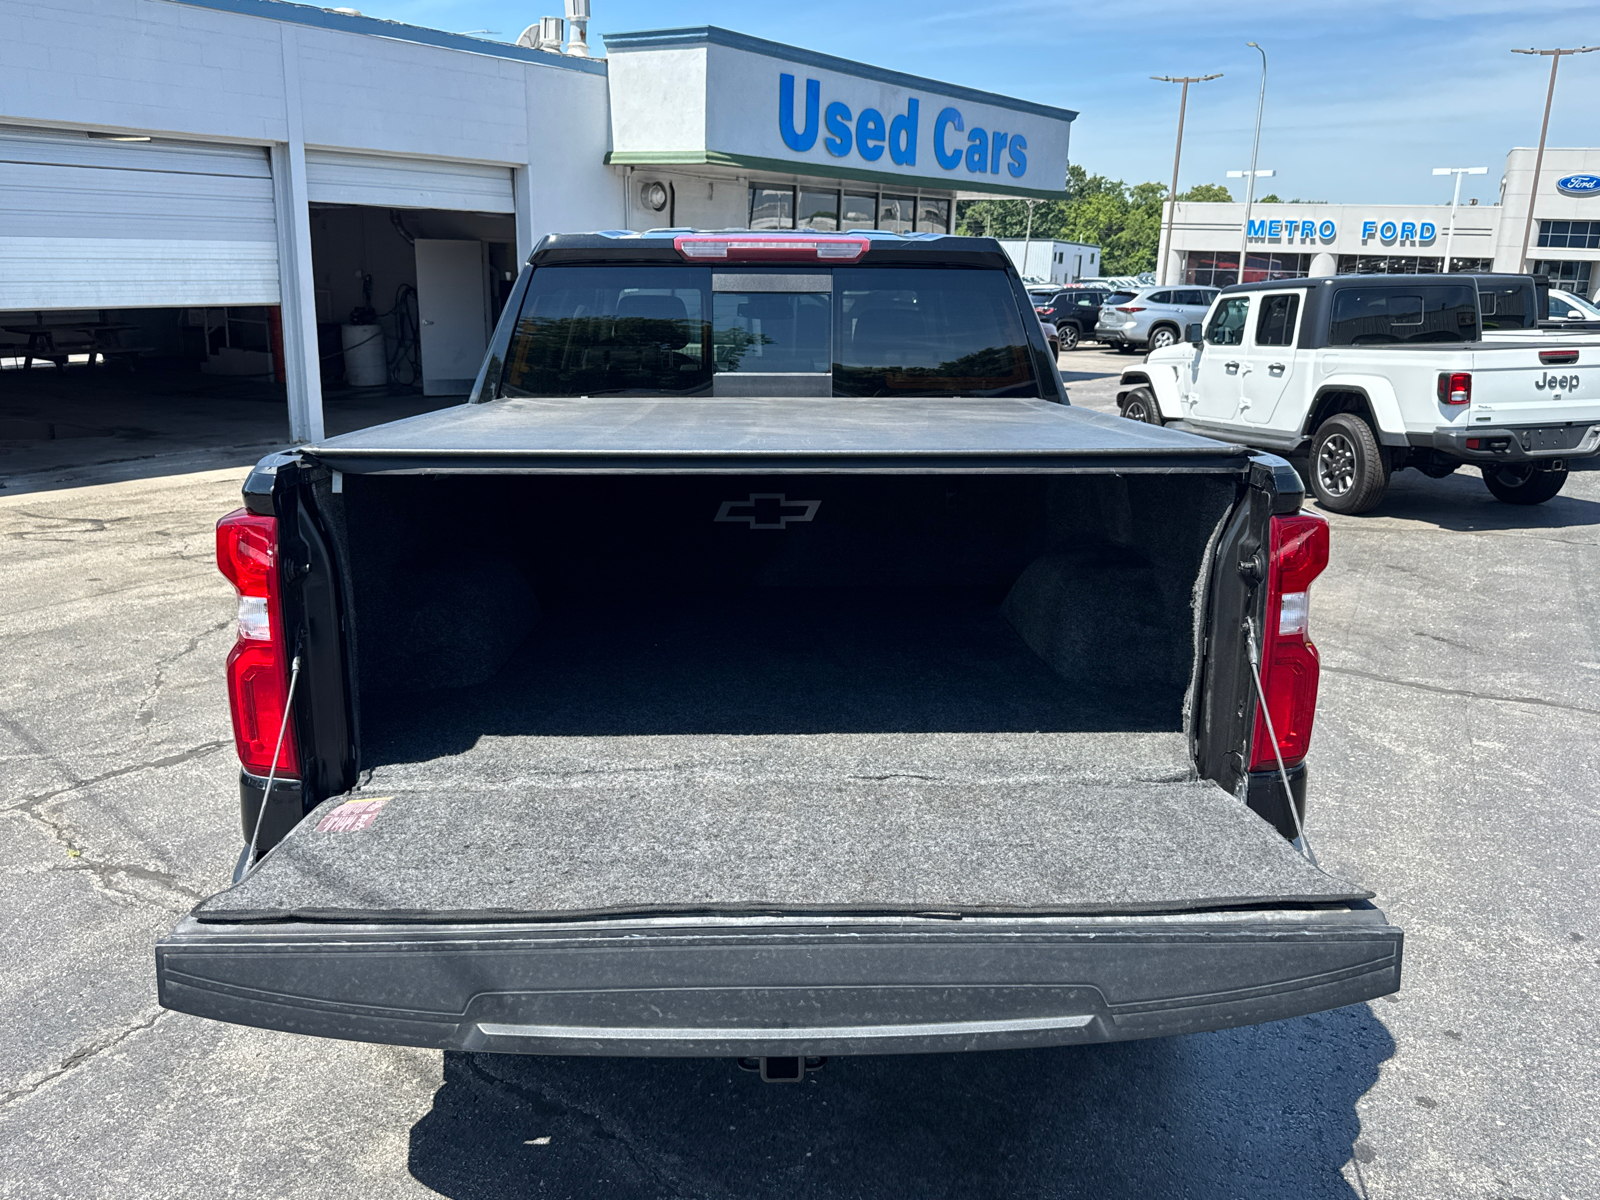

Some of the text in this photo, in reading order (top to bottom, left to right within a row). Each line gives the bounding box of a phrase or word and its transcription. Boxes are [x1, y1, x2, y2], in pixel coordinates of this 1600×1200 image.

[779, 73, 1027, 178] Used Cars
[1567, 177, 1597, 188] Ford
[1247, 219, 1436, 241] METRO FORD
[1535, 371, 1579, 393] Jeep
